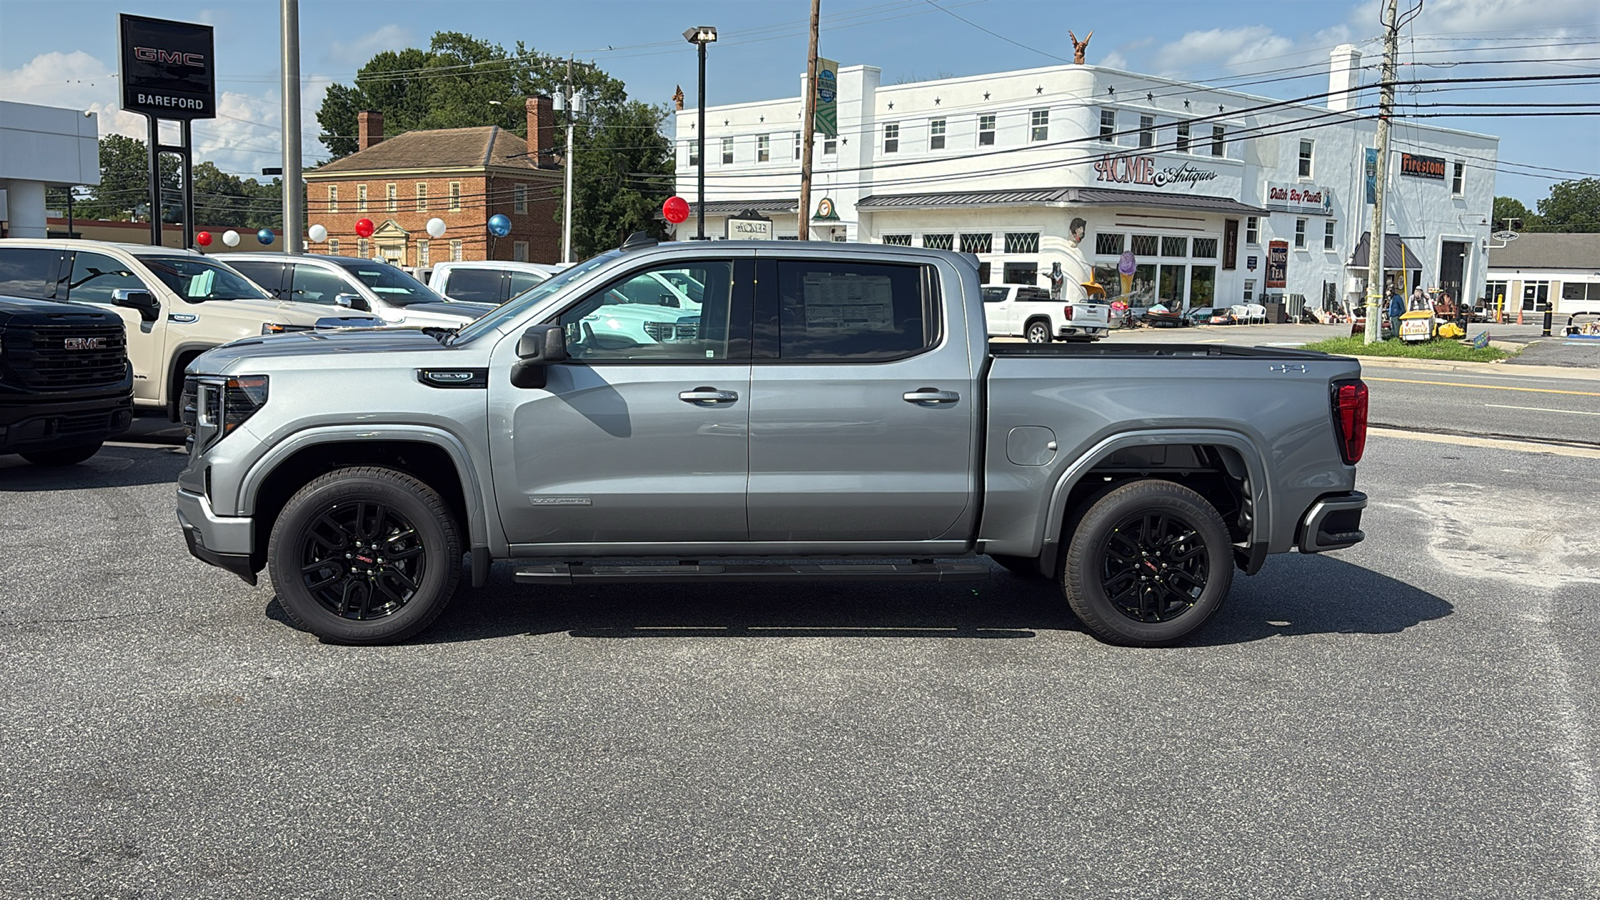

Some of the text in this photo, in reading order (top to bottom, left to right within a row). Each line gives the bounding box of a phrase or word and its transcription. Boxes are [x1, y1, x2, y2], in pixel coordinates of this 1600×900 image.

[134, 46, 204, 67] GMC
[137, 93, 204, 110] BAREFORD
[1094, 152, 1218, 188] ACME Antiques
[1402, 154, 1445, 175] Firestone
[1269, 187, 1322, 205] Dutch Boy Paints
[1271, 266, 1284, 279] TEA
[64, 338, 107, 350] GMC
